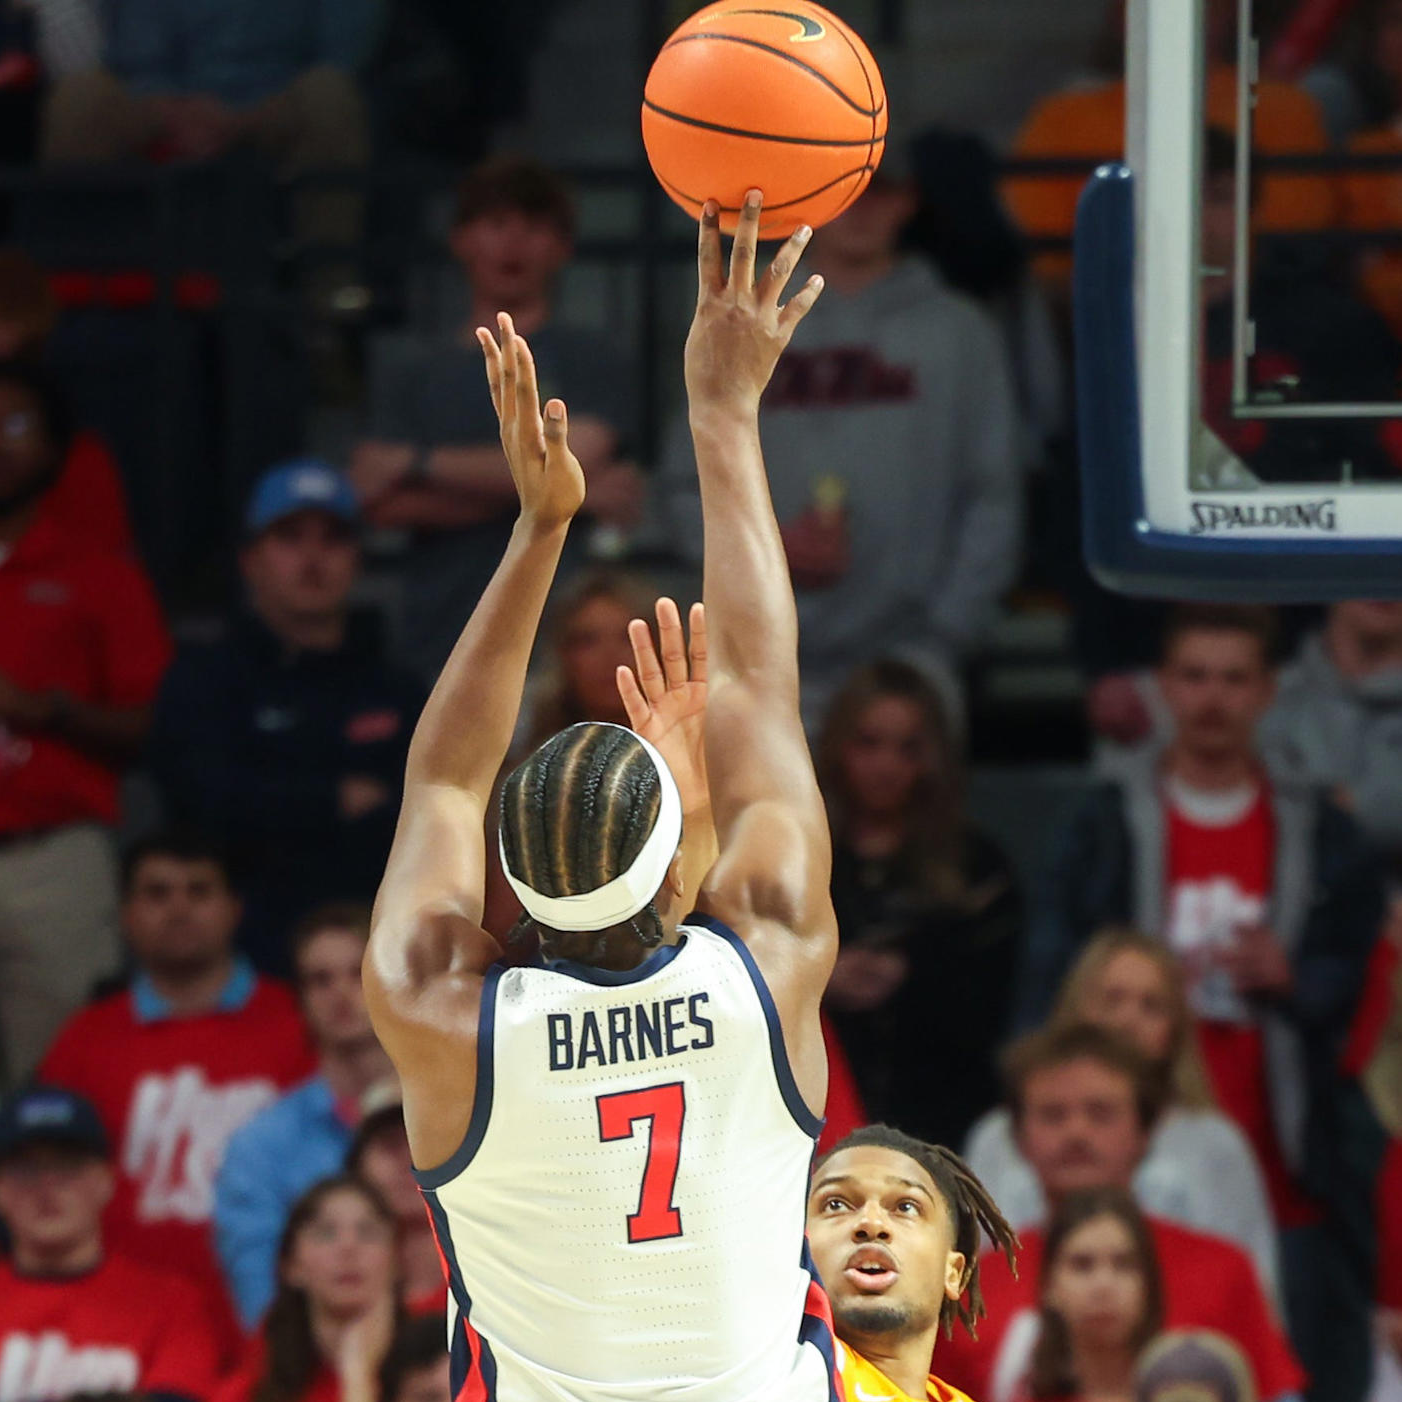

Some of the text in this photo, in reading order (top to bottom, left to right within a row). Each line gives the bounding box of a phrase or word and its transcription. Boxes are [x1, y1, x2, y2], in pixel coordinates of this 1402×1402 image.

[1189, 498, 1336, 535] SPALDING
[547, 992, 715, 1071] BARNES
[595, 1081, 686, 1244] 7
